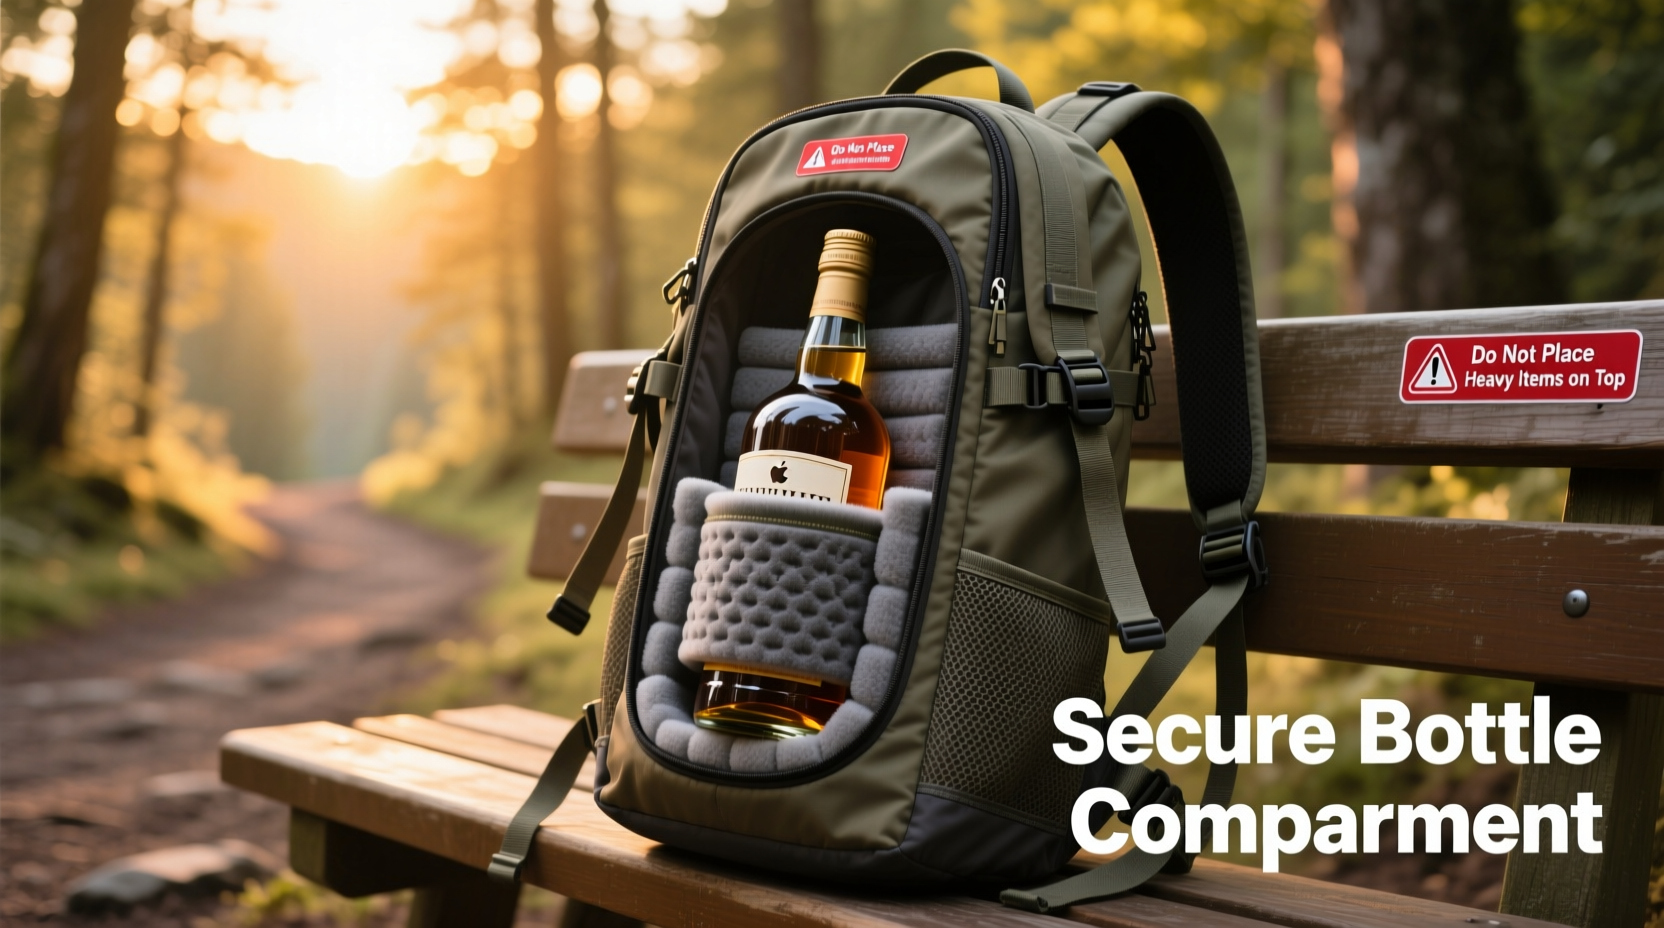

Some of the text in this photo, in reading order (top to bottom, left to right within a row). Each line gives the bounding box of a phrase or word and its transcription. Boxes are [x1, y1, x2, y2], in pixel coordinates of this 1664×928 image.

[1471, 342, 1595, 364] Do Not Place
[1464, 368, 1626, 392] Heavy Items on Top
